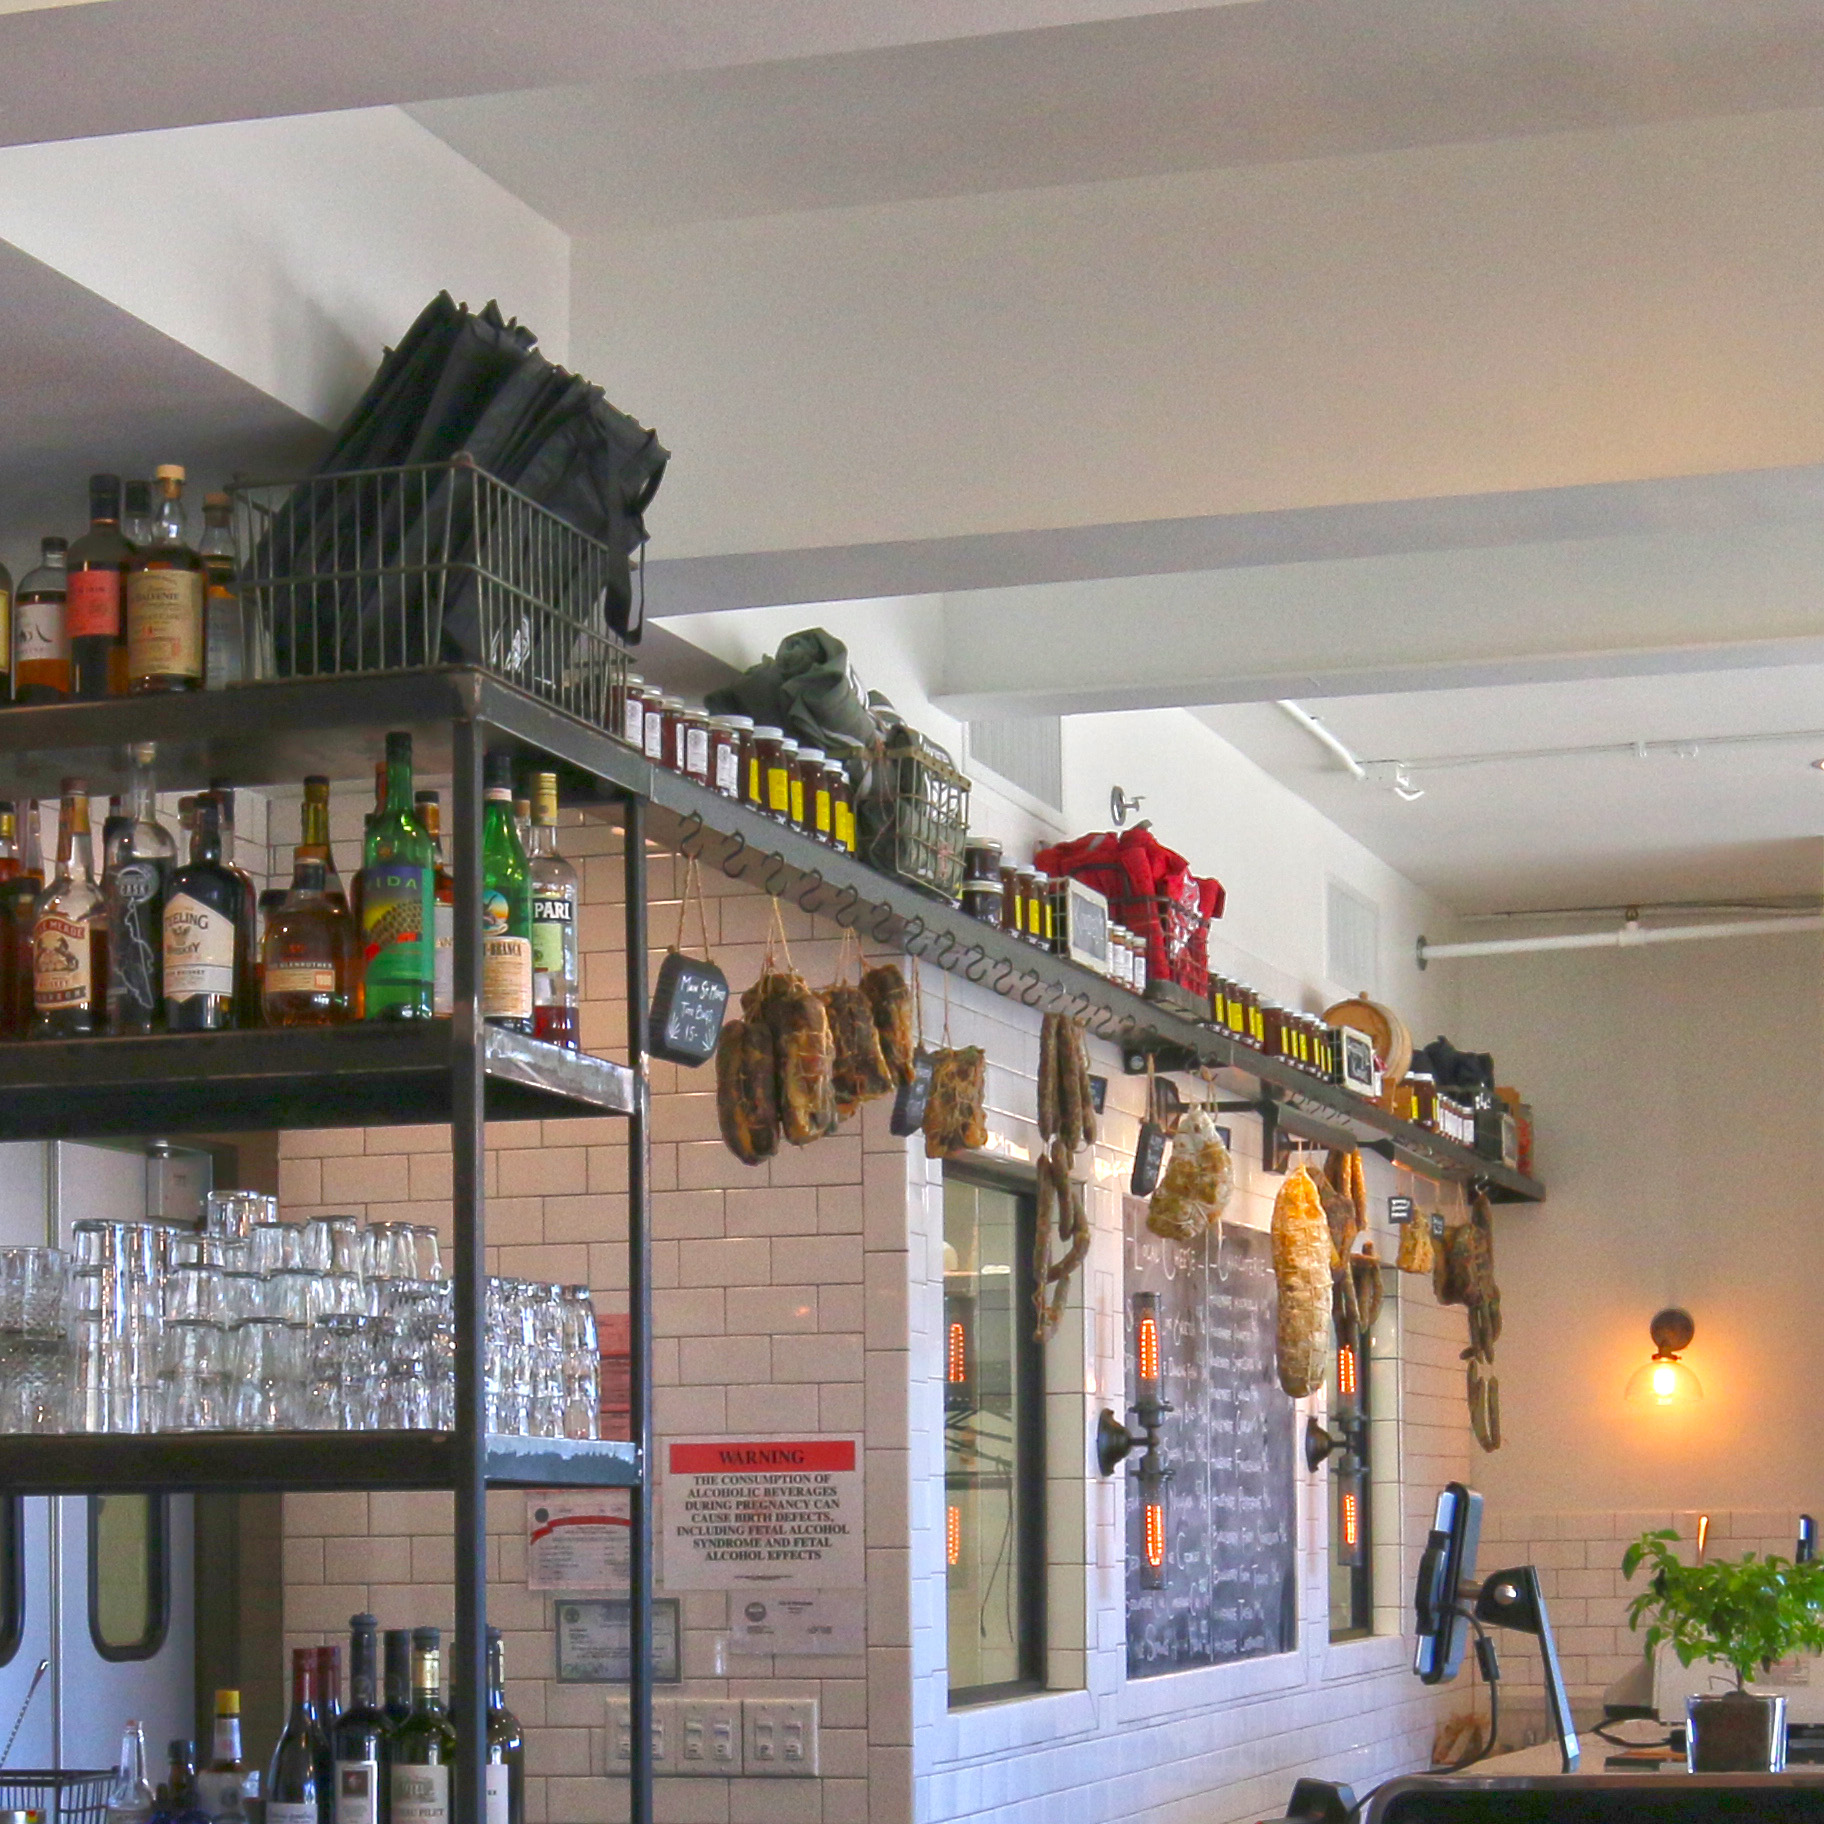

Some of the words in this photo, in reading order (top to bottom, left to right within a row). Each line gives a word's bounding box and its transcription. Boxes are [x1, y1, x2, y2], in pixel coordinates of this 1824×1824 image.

[367, 875, 417, 890] IDA
[534, 900, 571, 920] PARI
[719, 1450, 804, 1464] WARNING
[693, 1476, 717, 1485] THE
[721, 1474, 811, 1486] CONSUMPTION
[815, 1474, 831, 1484] OF
[688, 1488, 760, 1498] ALCOHOLIC
[764, 1487, 837, 1498] BEVERAGES
[685, 1500, 732, 1511] DURING
[735, 1499, 809, 1510] PREGNANCY
[814, 1499, 840, 1509] CAN
[691, 1513, 732, 1524] CAUSE
[735, 1512, 772, 1523] BIRTH
[677, 1526, 745, 1536] INCLUDING
[748, 1525, 788, 1536] FETAL
[790, 1524, 850, 1535] ALCOHOL
[693, 1539, 760, 1549] SYNDROME
[765, 1538, 790, 1548] AND
[793, 1537, 832, 1548] FETAL
[705, 1551, 766, 1561] ALCOHOL
[768, 1550, 822, 1561] EFFECTS
